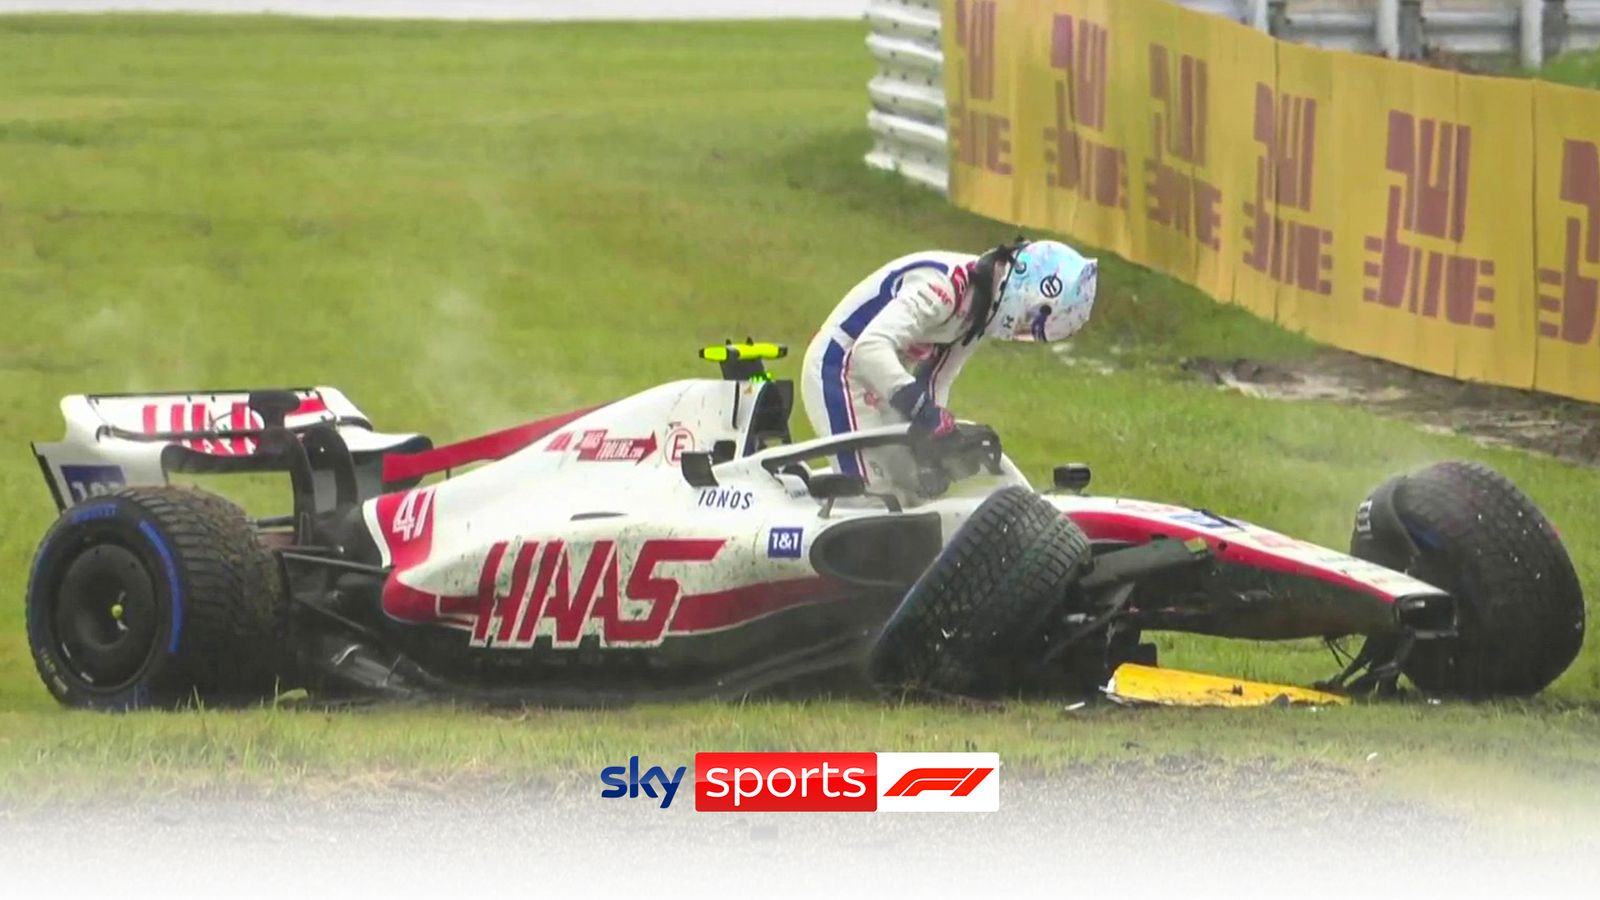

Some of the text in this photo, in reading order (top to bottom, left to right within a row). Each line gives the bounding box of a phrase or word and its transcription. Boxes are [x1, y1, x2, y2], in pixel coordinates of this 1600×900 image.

[1247, 80, 1331, 294] DHL
[1366, 108, 1493, 328] DHL
[392, 488, 436, 541] 47
[698, 489, 753, 510] IONOS
[772, 532, 799, 550] 1&1
[470, 539, 727, 648] HAAS
